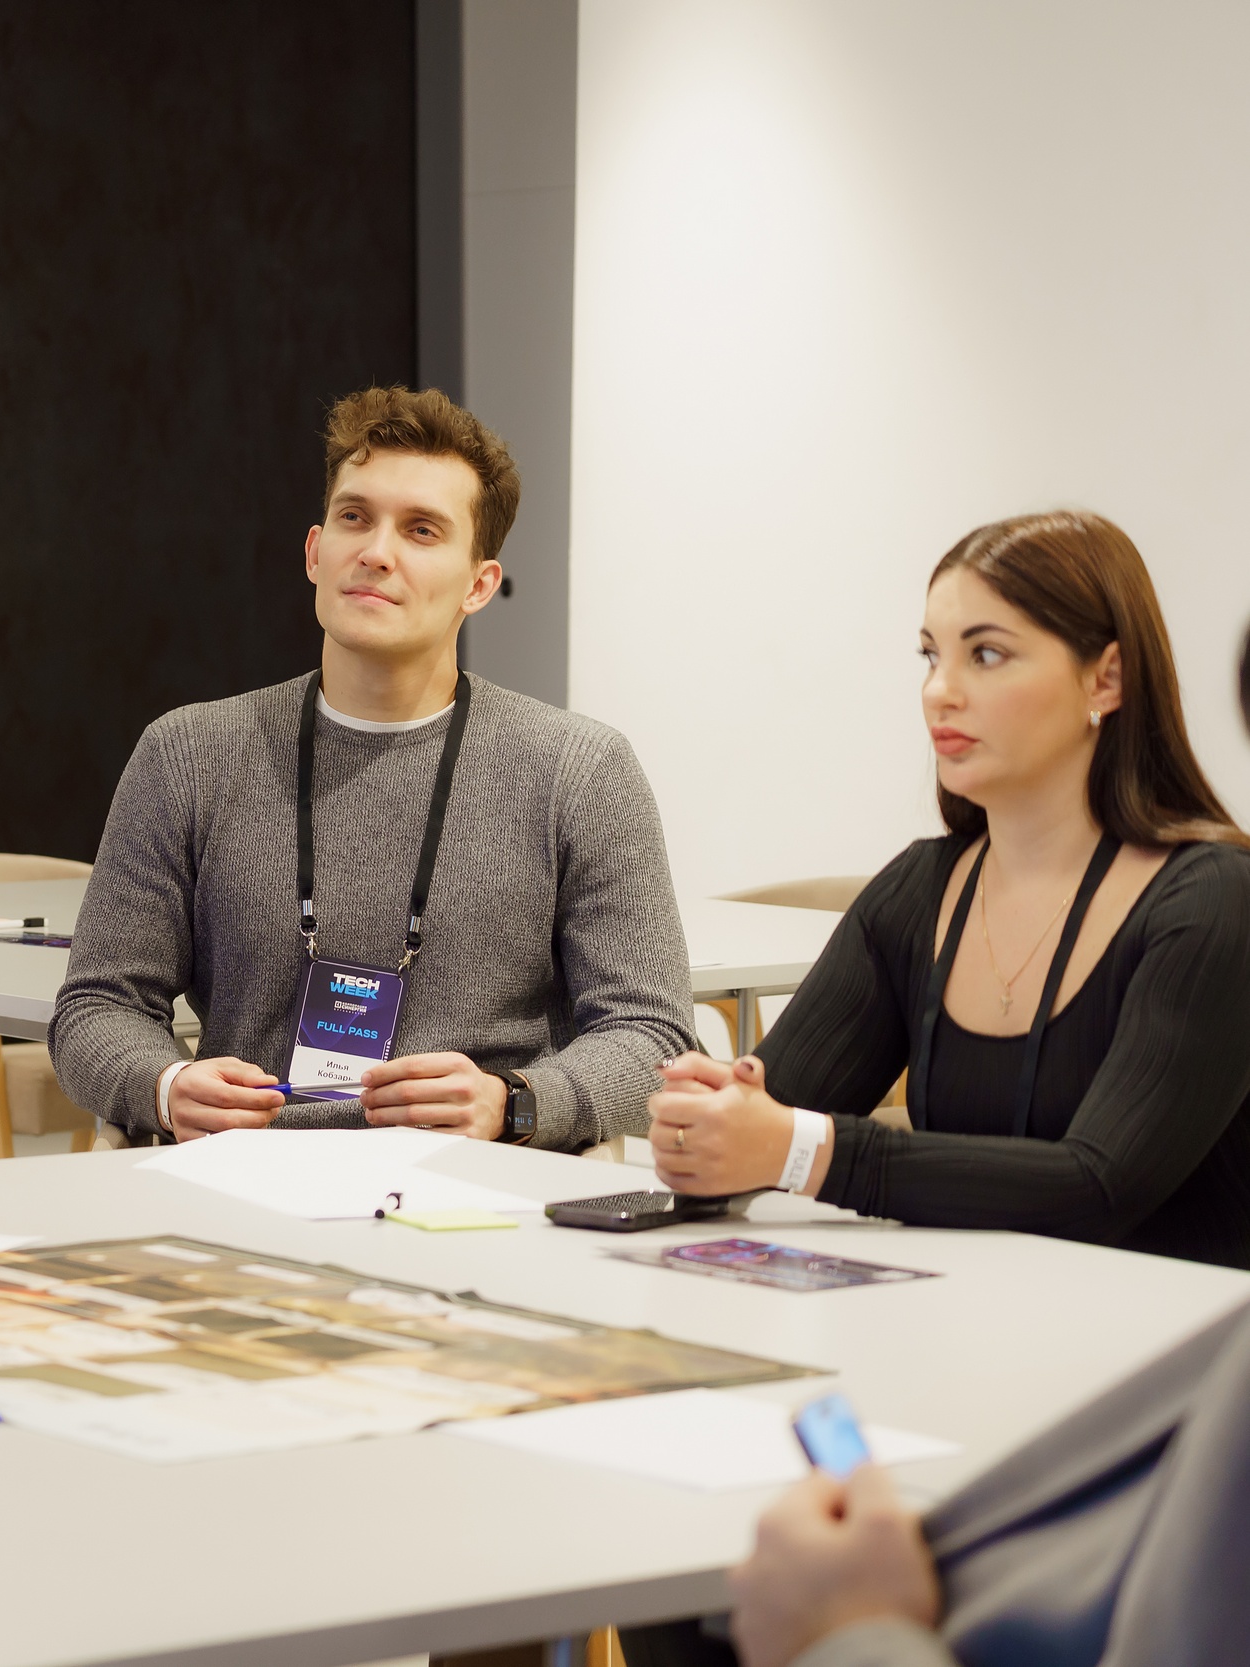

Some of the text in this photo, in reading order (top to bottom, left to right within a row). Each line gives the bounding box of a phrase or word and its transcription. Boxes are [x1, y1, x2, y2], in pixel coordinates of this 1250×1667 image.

[333, 973, 380, 990] TECH
[330, 982, 377, 999] WEEK
[317, 1021, 378, 1039] FULL PASS
[326, 1060, 349, 1070] Илья
